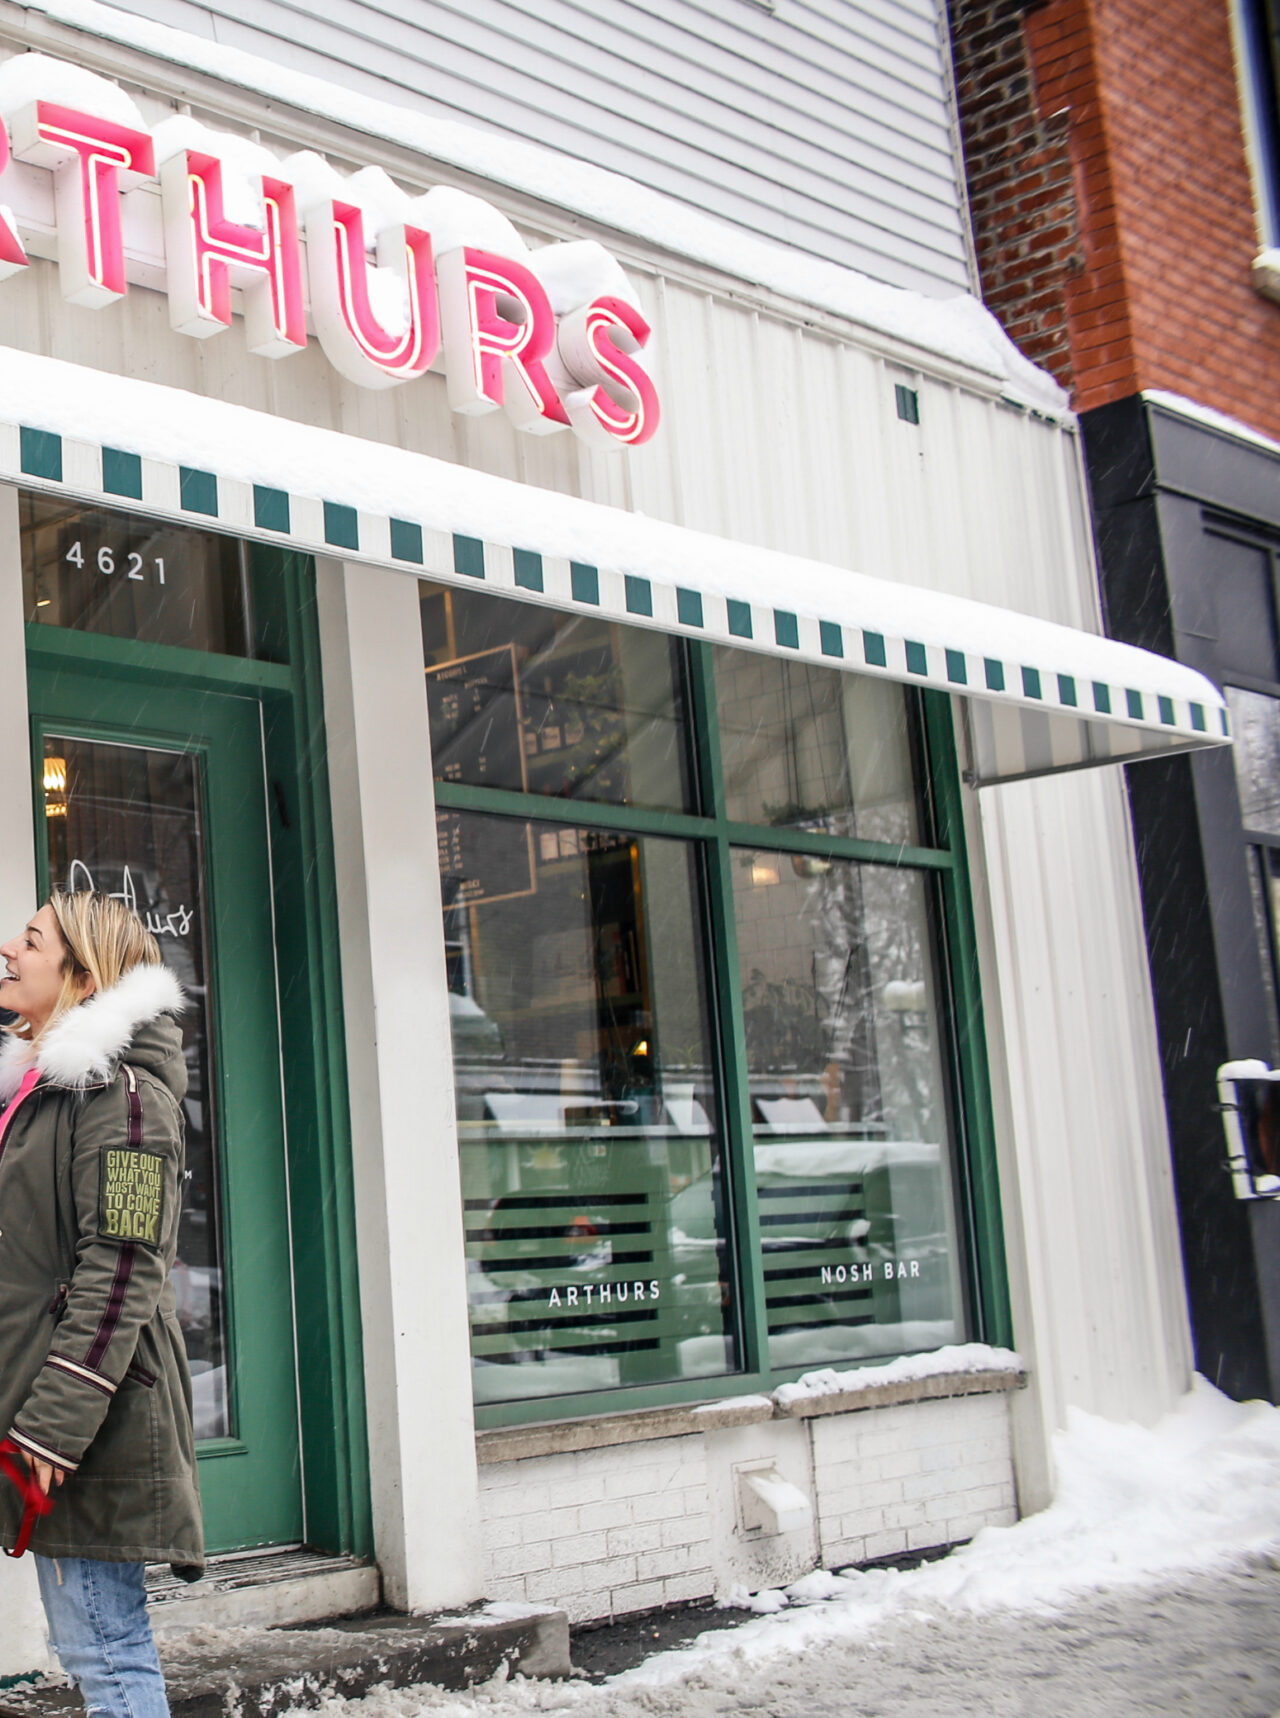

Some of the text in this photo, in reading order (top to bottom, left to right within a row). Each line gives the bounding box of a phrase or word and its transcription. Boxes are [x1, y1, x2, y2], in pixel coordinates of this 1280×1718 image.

[65, 541, 166, 585] 4621
[107, 1150, 162, 1173] GIVE OUT
[107, 1167, 161, 1187] WHAT YOU
[106, 1181, 161, 1200] MOST WANT
[105, 1193, 160, 1216] TO COME
[105, 1209, 159, 1243] BACK
[548, 1260, 921, 1308] ARTHURS NOSH BAR
